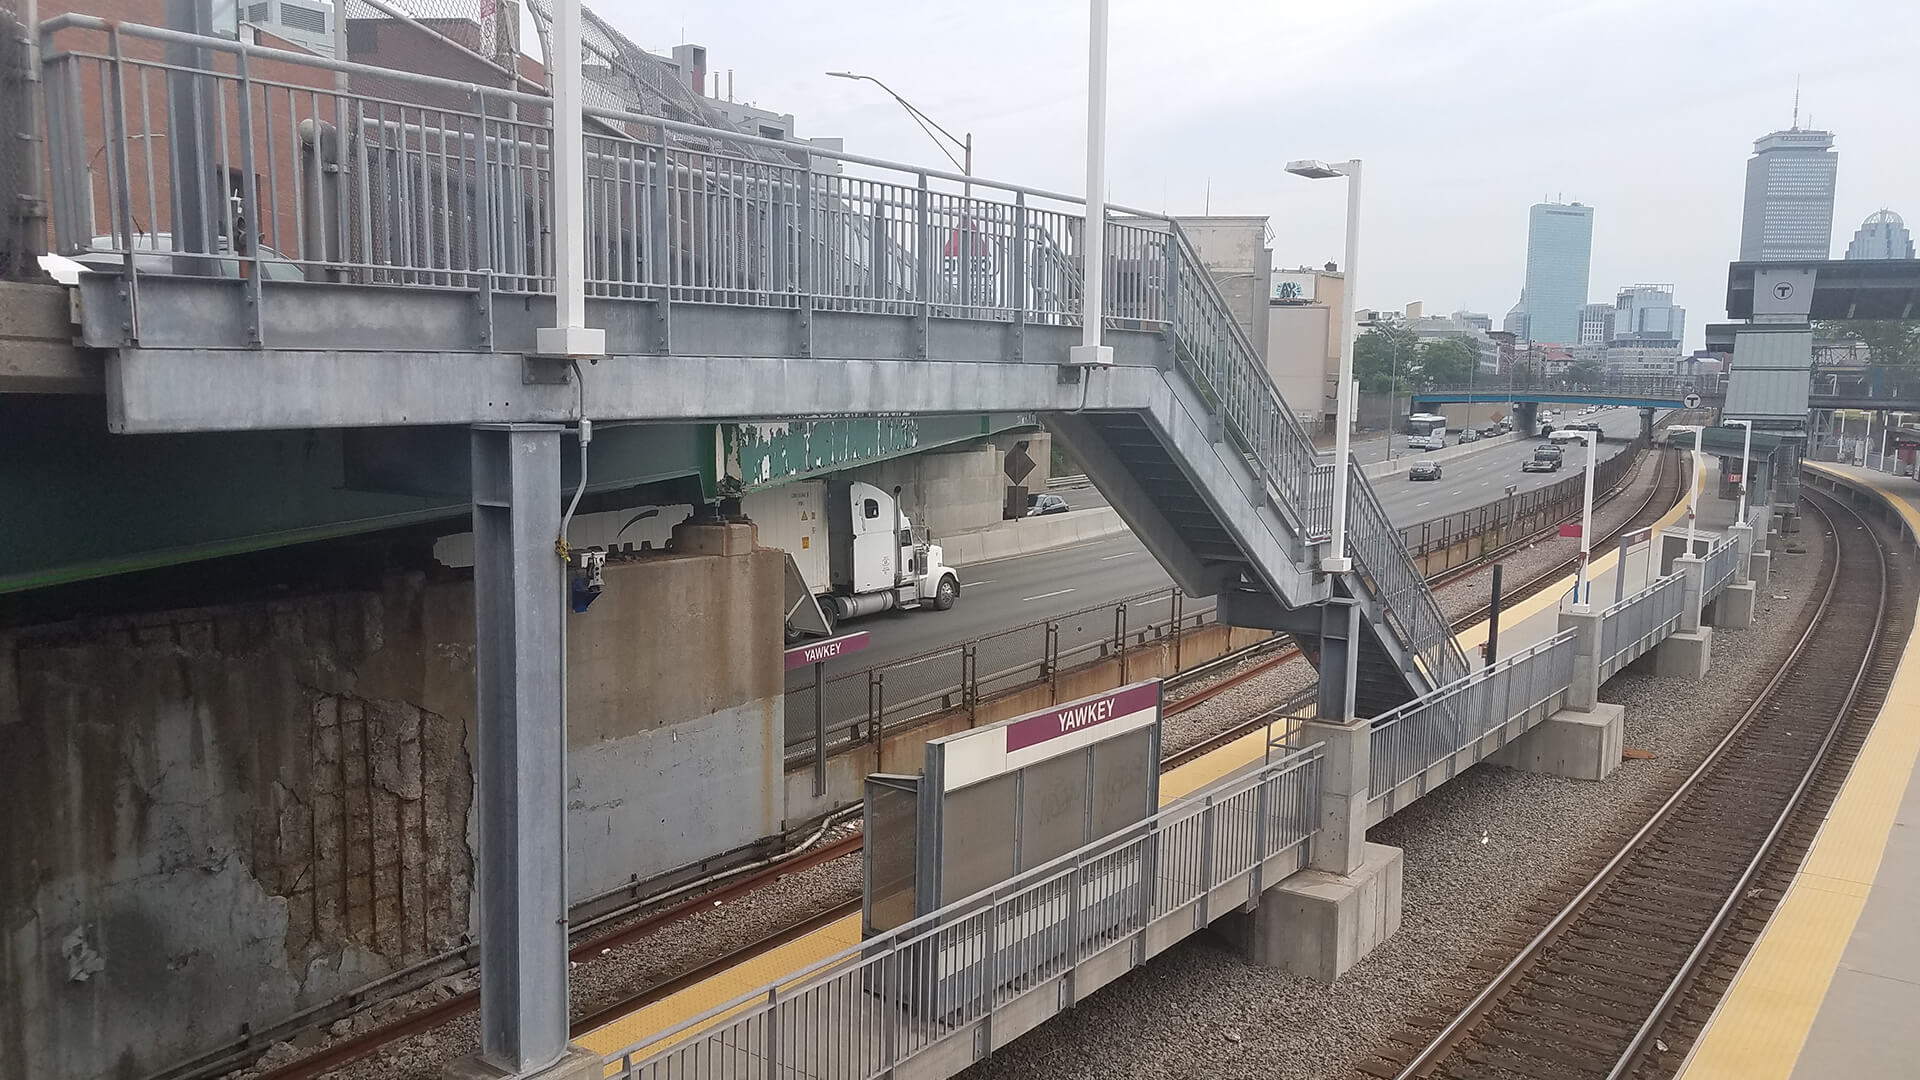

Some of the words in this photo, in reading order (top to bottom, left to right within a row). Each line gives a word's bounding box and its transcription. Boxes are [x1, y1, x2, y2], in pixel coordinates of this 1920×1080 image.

[1777, 286, 1790, 297] T
[804, 642, 842, 662] YAWKEY
[1058, 698, 1115, 732] YAWKEY
